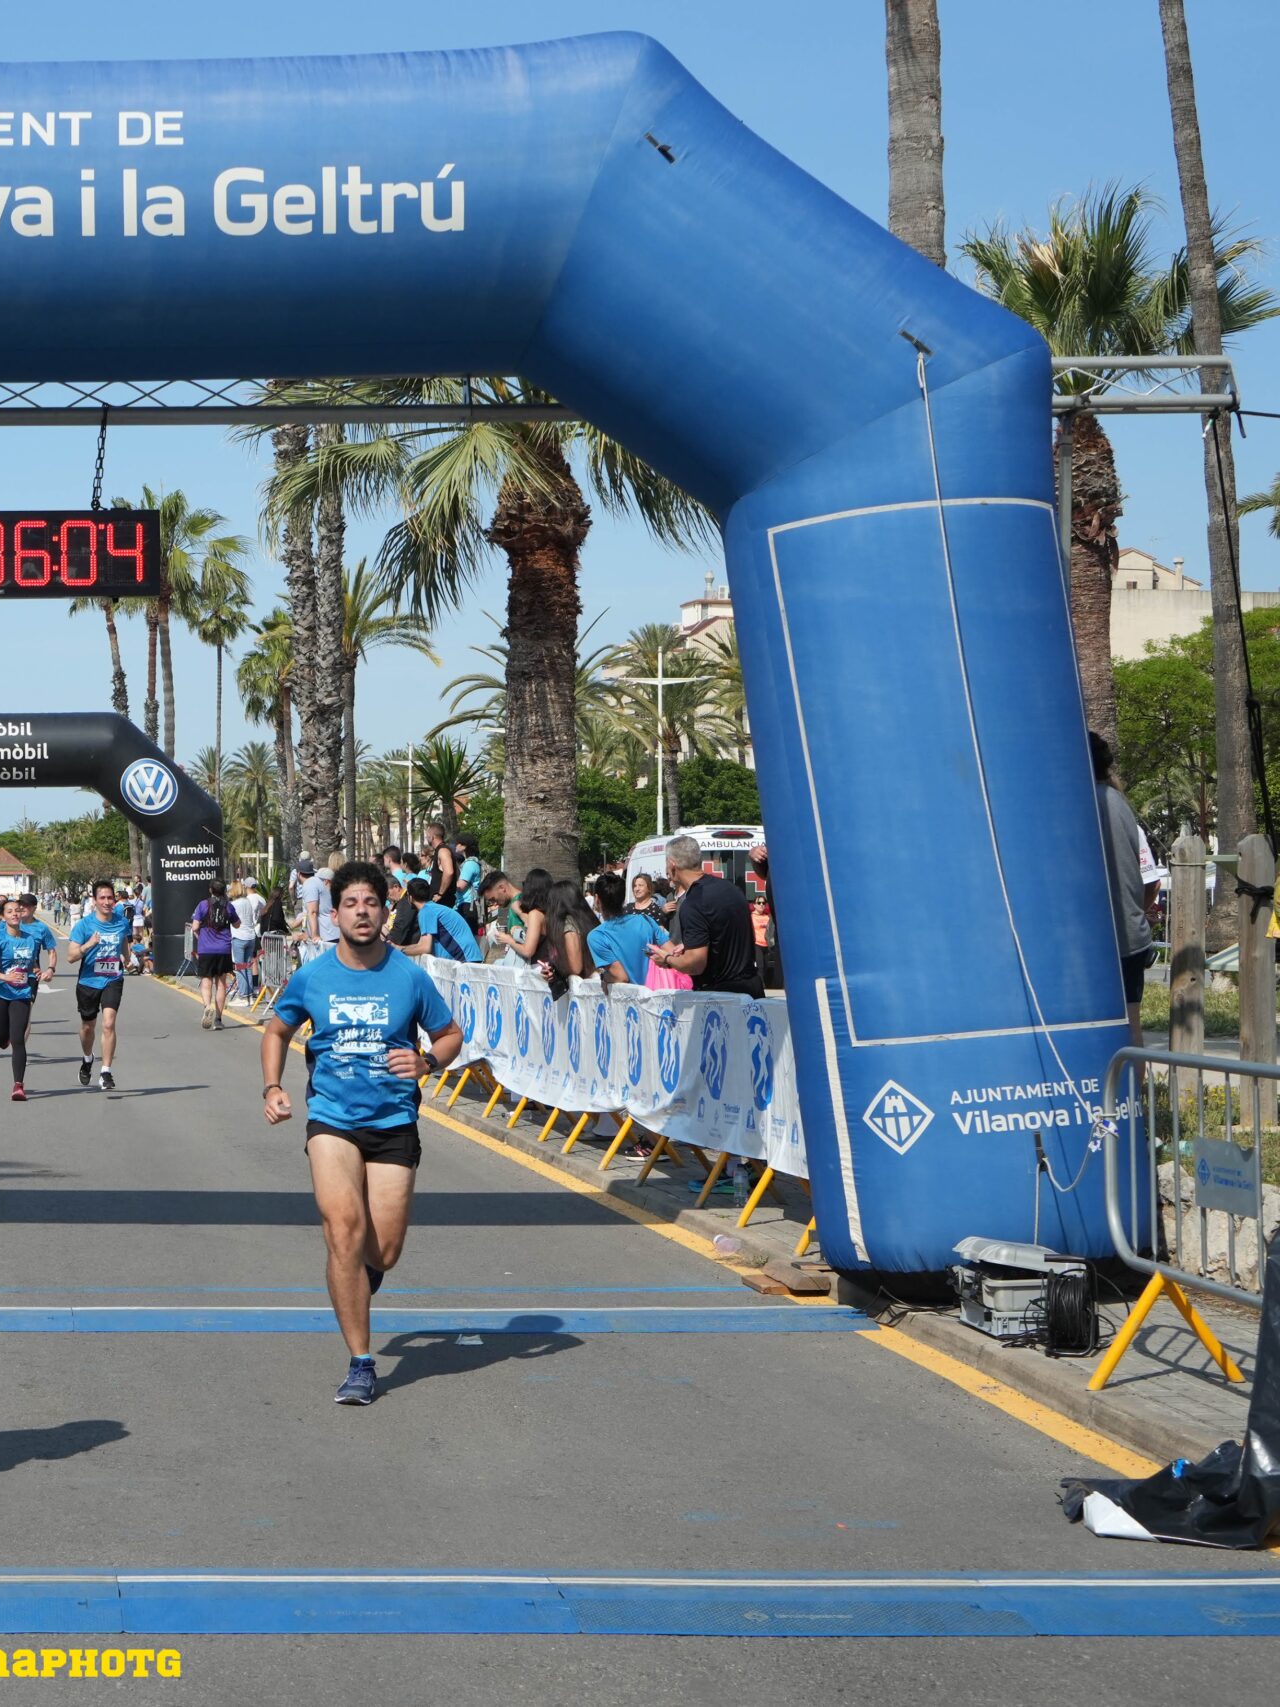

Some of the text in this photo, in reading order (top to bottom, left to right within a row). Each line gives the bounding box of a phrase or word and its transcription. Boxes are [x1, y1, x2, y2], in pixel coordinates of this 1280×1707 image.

[118, 111, 184, 146] DE
[80, 168, 96, 237] i
[122, 168, 186, 237] la
[212, 163, 465, 237] Geltrú
[166, 844, 215, 855] Vilamòbil
[160, 857, 220, 868] Tarracomòbil
[165, 870, 217, 881] Reusmòbil
[99, 962, 115, 970] 712
[950, 1078, 1100, 1105] AJUNTAMENT DE
[952, 1108, 1070, 1135] Vilanova
[1074, 1102, 1082, 1125] i
